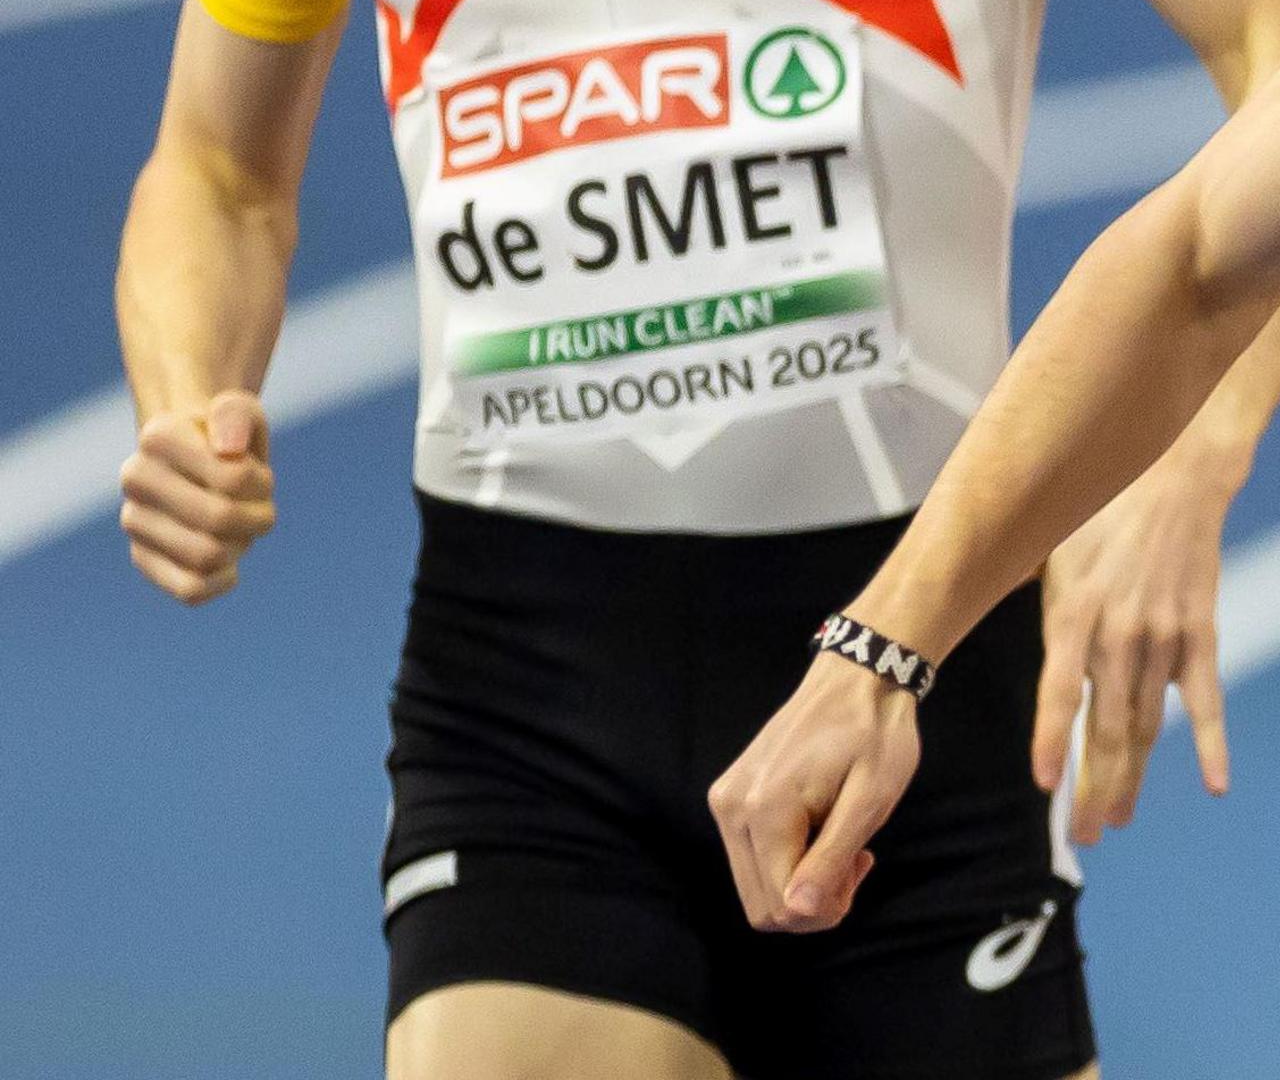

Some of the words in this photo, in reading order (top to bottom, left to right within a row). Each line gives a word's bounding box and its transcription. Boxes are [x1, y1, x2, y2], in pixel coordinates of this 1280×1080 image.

[445, 46, 723, 170] SPAR
[436, 200, 545, 294] de
[566, 146, 848, 274] SMET
[481, 357, 755, 429] APELDOORN
[769, 327, 881, 386] 2025
[528, 329, 542, 363] I
[546, 317, 629, 360] RUN
